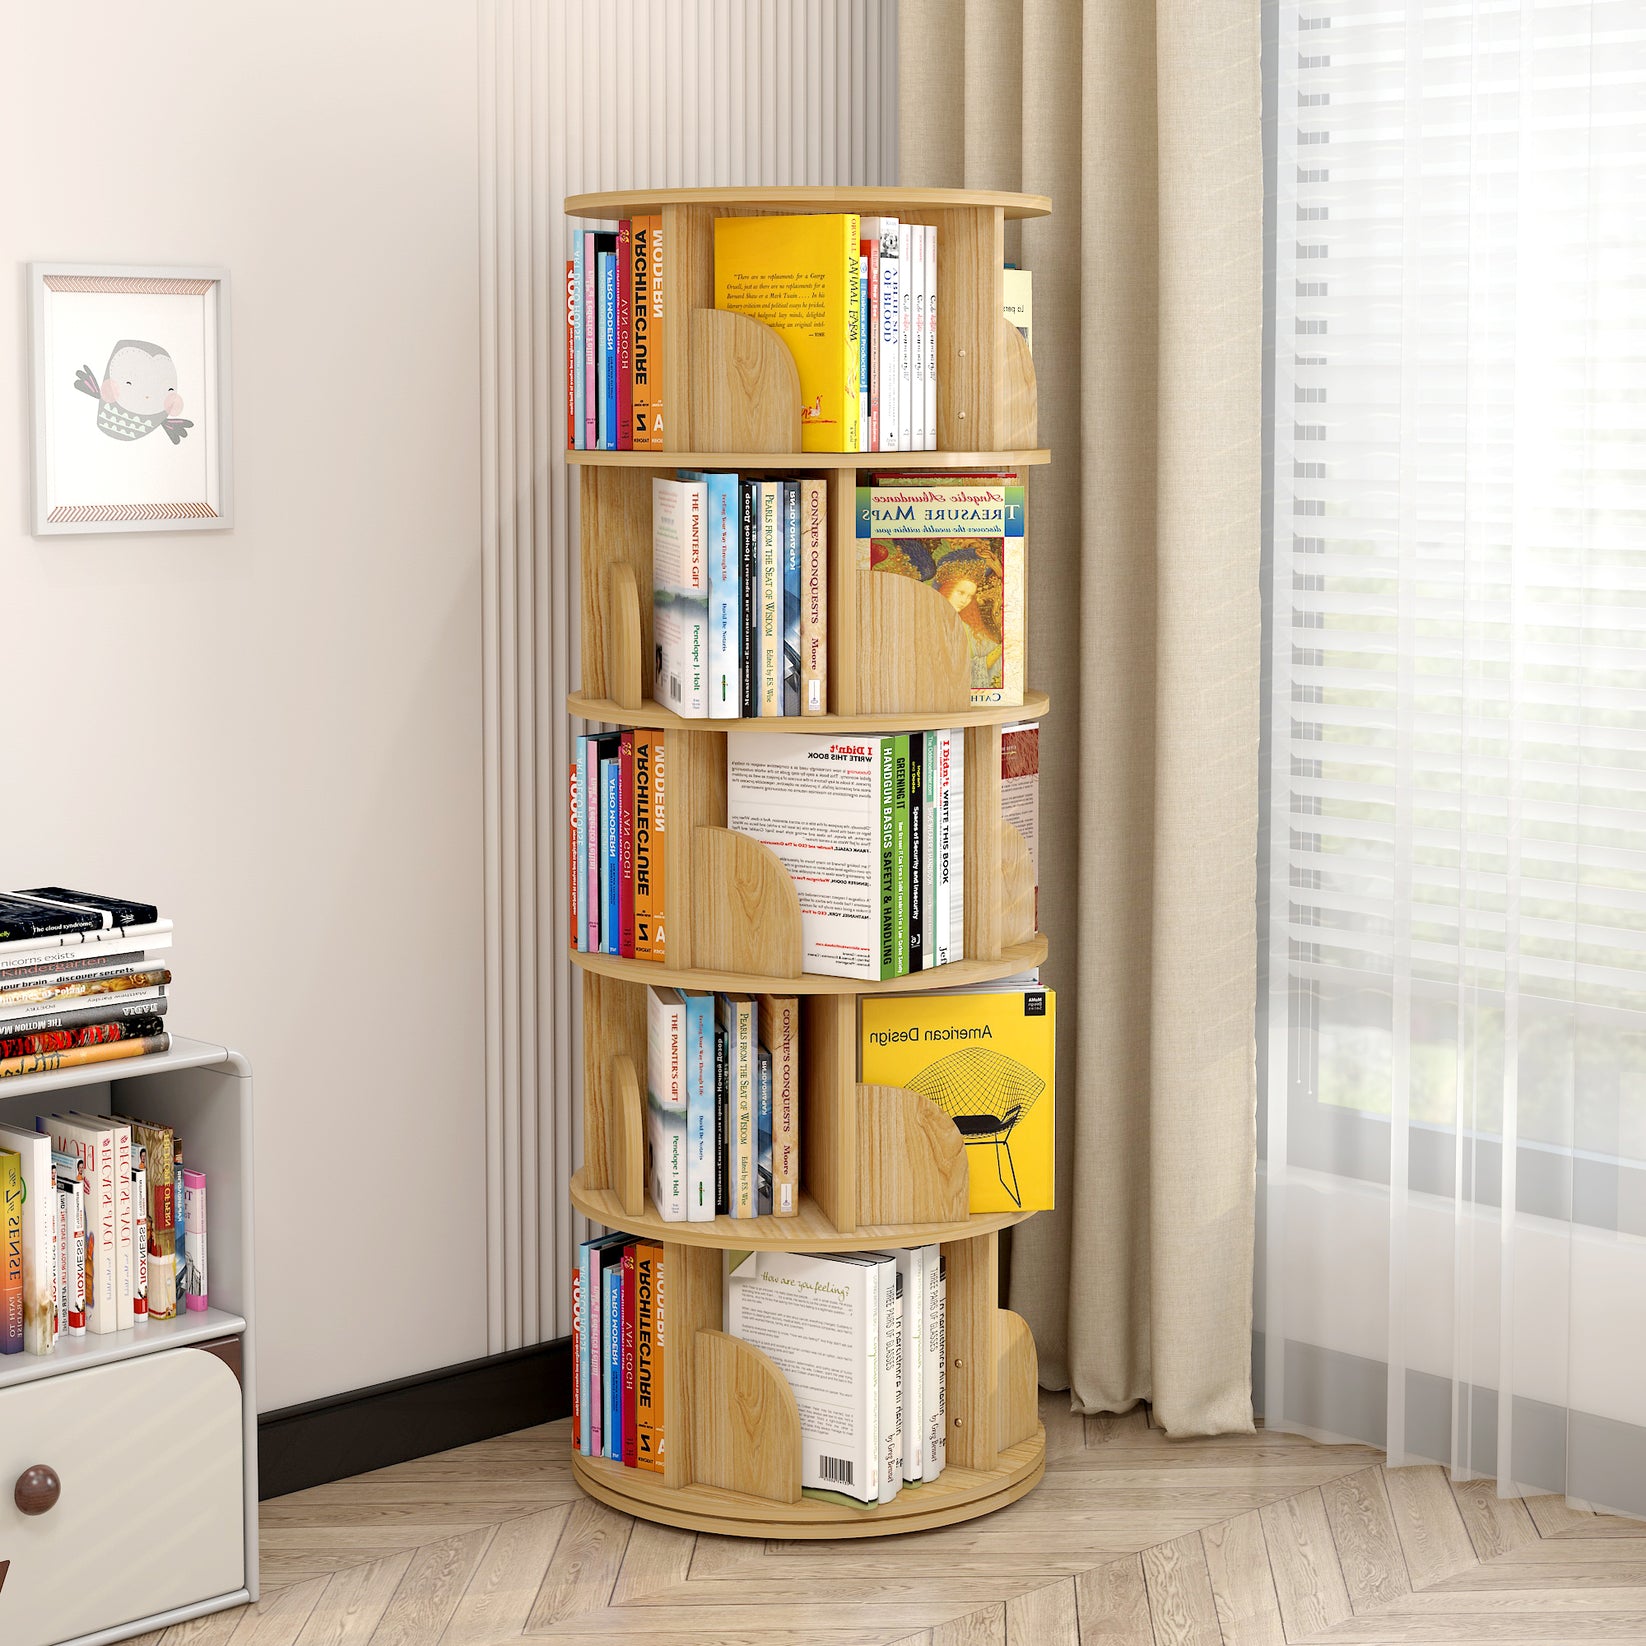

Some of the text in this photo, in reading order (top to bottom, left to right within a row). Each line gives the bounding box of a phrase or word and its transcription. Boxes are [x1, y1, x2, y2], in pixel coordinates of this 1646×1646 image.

[849, 257, 859, 306] ANIMAL
[884, 270, 892, 342] OF BLOOD
[850, 310, 859, 342] FARM
[811, 490, 819, 548] CONNIE'S
[692, 493, 700, 588] THE PAINTER'S GIFT
[765, 494, 775, 636] PEARLS FROM THE SEAT OF WISDOM
[810, 550, 819, 624] CONQUESTS
[692, 624, 700, 660] Penelope
[766, 649, 774, 668] Edited
[896, 758, 905, 800] GREENING
[912, 806, 920, 832] Spaces
[884, 748, 892, 964] HANDGUN BASICS SAFETY & HANDLING
[912, 840, 920, 865] Security
[912, 868, 920, 882] and
[912, 884, 920, 919] Insecurity
[46, 924, 62, 932] cloud
[63, 921, 93, 931] syndrome
[2, 957, 107, 977] Kindergarten
[44, 952, 75, 962] exists
[21, 978, 47, 989] brain
[56, 972, 97, 983] discover
[99, 967, 134, 976] secrets
[14, 1020, 46, 1034] MOTION
[48, 1018, 62, 1028] THE
[782, 1009, 790, 1062] CONNIE'S
[671, 1014, 679, 1102] THE PAINTER'S GIFT
[782, 1064, 790, 1132] CONQUESTS
[672, 1135, 680, 1170] Penelope
[672, 1180, 680, 1196] Holt
[760, 1272, 850, 1302] How are you feeling?
[886, 1285, 894, 1370] THREE PAIRS OF GLASSES
[885, 1434, 894, 1442] by
[885, 1444, 894, 1458] Greg
